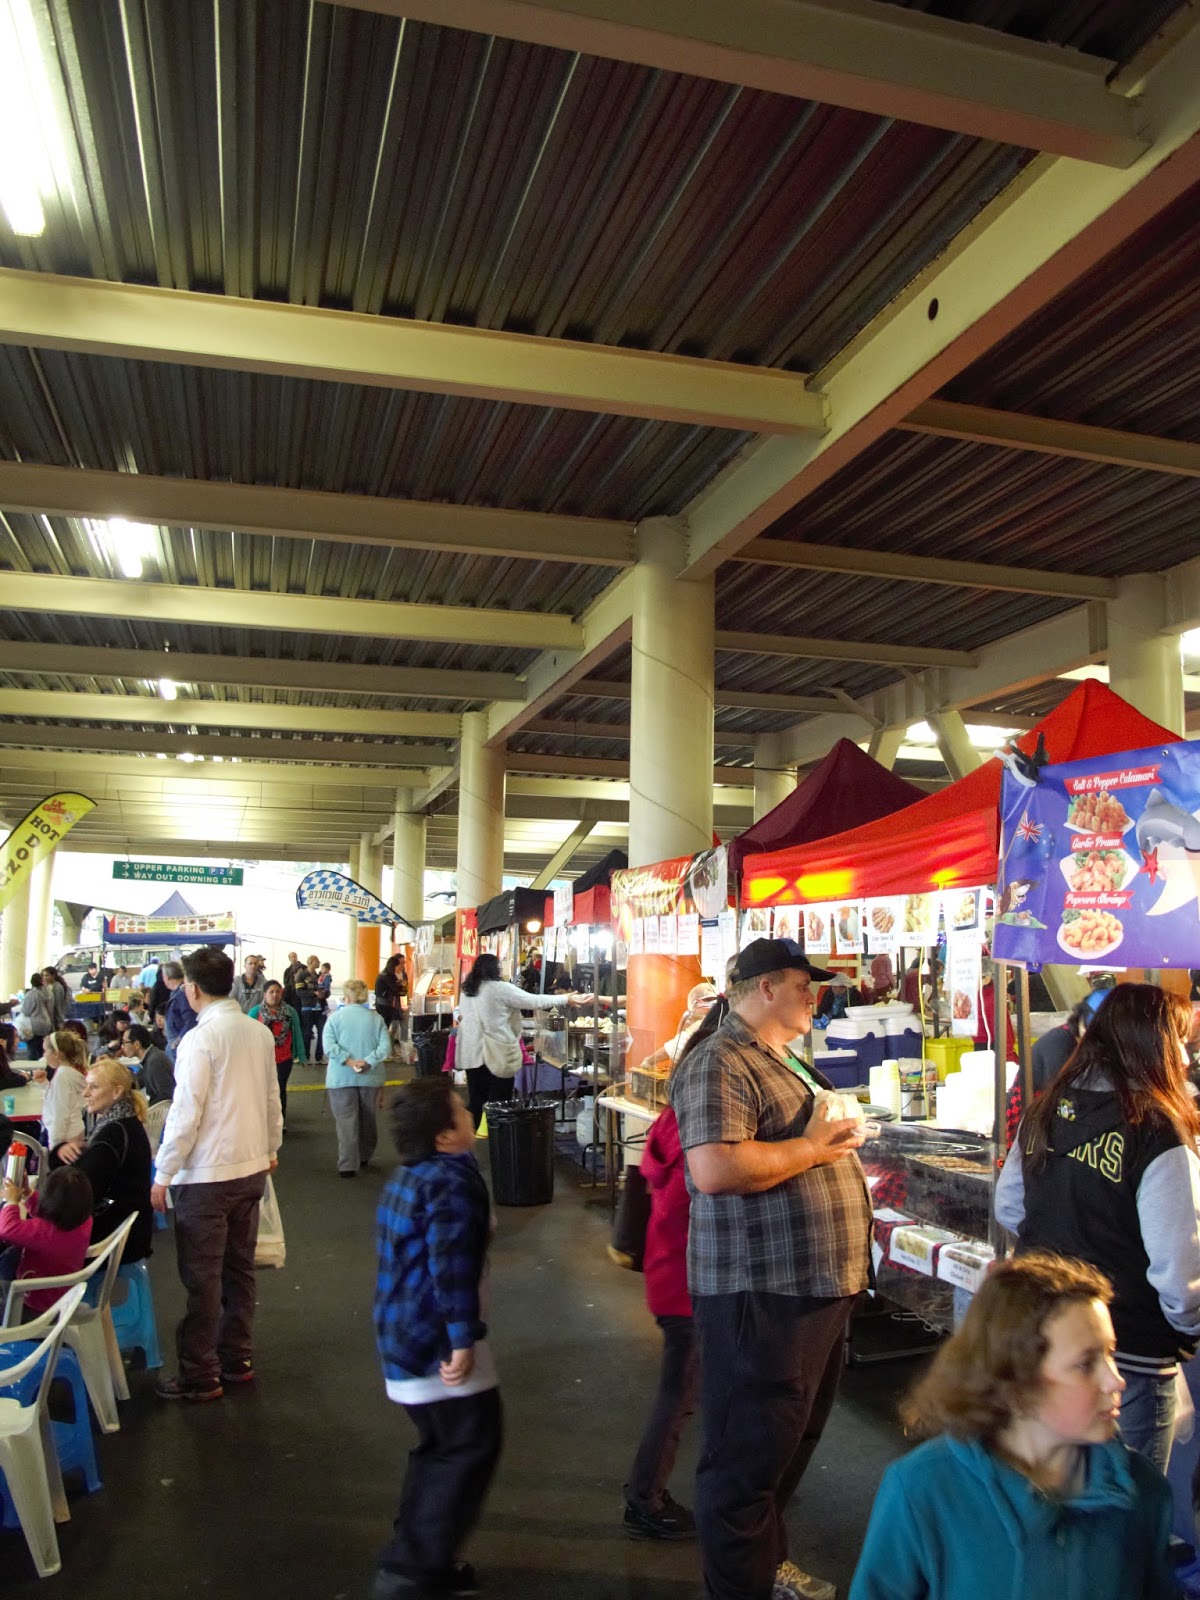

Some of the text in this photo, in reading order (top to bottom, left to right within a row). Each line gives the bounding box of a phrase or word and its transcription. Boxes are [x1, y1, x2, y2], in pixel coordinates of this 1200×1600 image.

[1086, 780, 1092, 789] &
[1093, 776, 1118, 790] Pepper
[1119, 768, 1155, 784] Calamari
[29, 815, 60, 841] HOT
[1071, 836, 1120, 849] Garlic Prawn
[134, 863, 163, 872] UPPER
[166, 865, 205, 874] PARKING
[134, 871, 153, 880] WAY
[156, 873, 174, 881] OUT
[177, 874, 219, 883] DOWNING
[1065, 892, 1127, 908] Popcorn Shrimp
